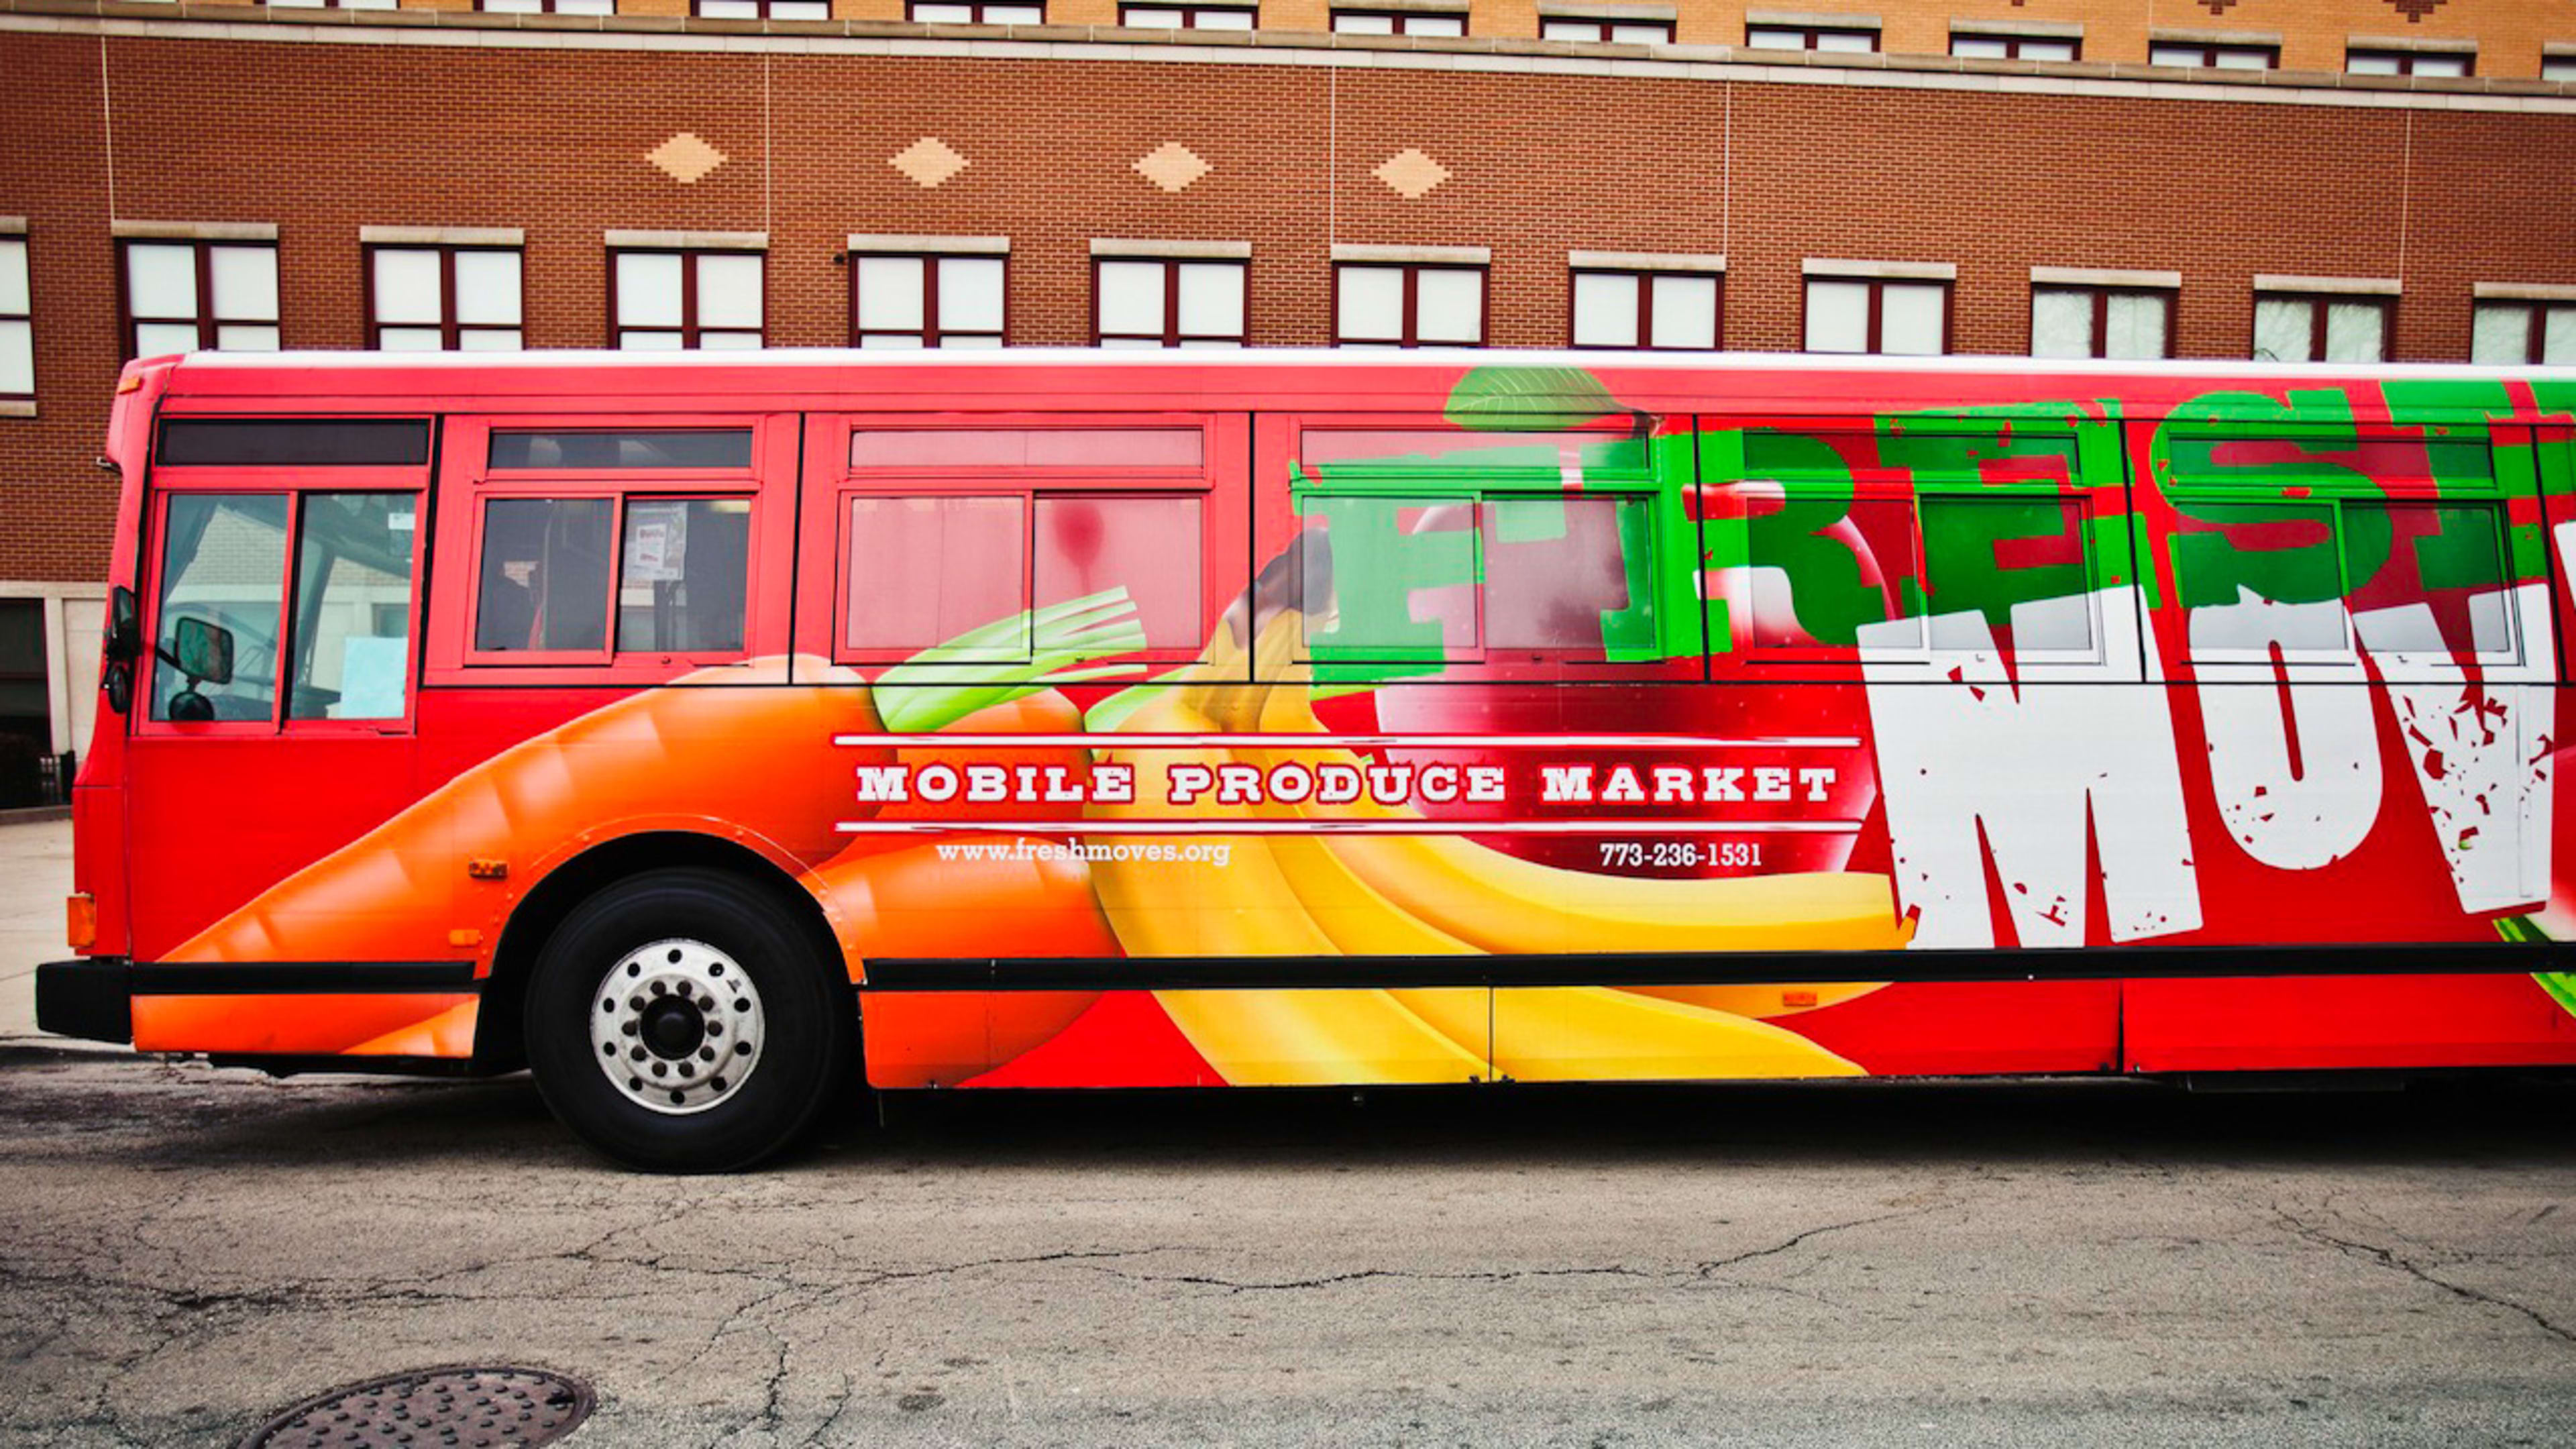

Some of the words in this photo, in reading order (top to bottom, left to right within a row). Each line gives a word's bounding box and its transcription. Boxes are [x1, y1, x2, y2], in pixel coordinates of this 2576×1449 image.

[1856, 519, 2576, 949] MOV
[857, 766, 1132, 802] MOBILE
[1168, 766, 1506, 802] PRODUCE
[1542, 767, 1837, 802] MARKET
[935, 838, 1231, 866] www.freshmoves.org
[1599, 843, 1762, 867] 773-236-1531
